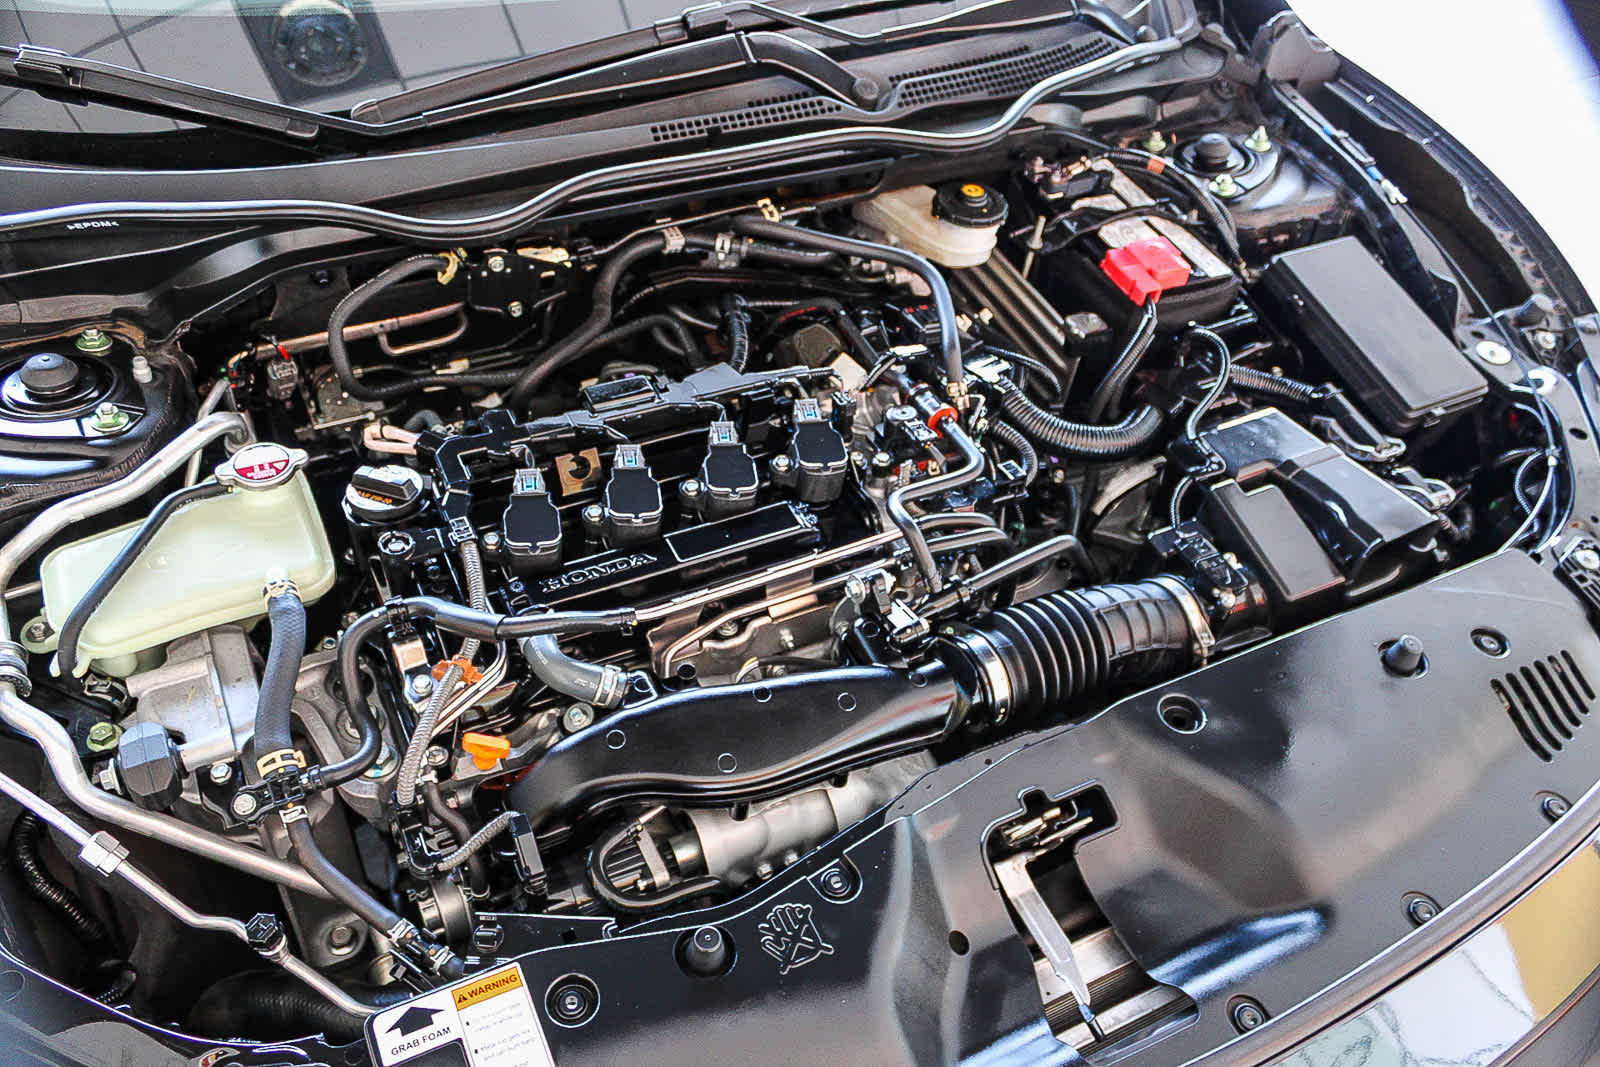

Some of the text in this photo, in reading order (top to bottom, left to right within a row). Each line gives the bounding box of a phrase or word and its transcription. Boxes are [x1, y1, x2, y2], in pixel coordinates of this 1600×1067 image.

[539, 553, 658, 593] HONDA
[467, 974, 518, 998] WARNING
[391, 1026, 452, 1056] GRAB FOAM
